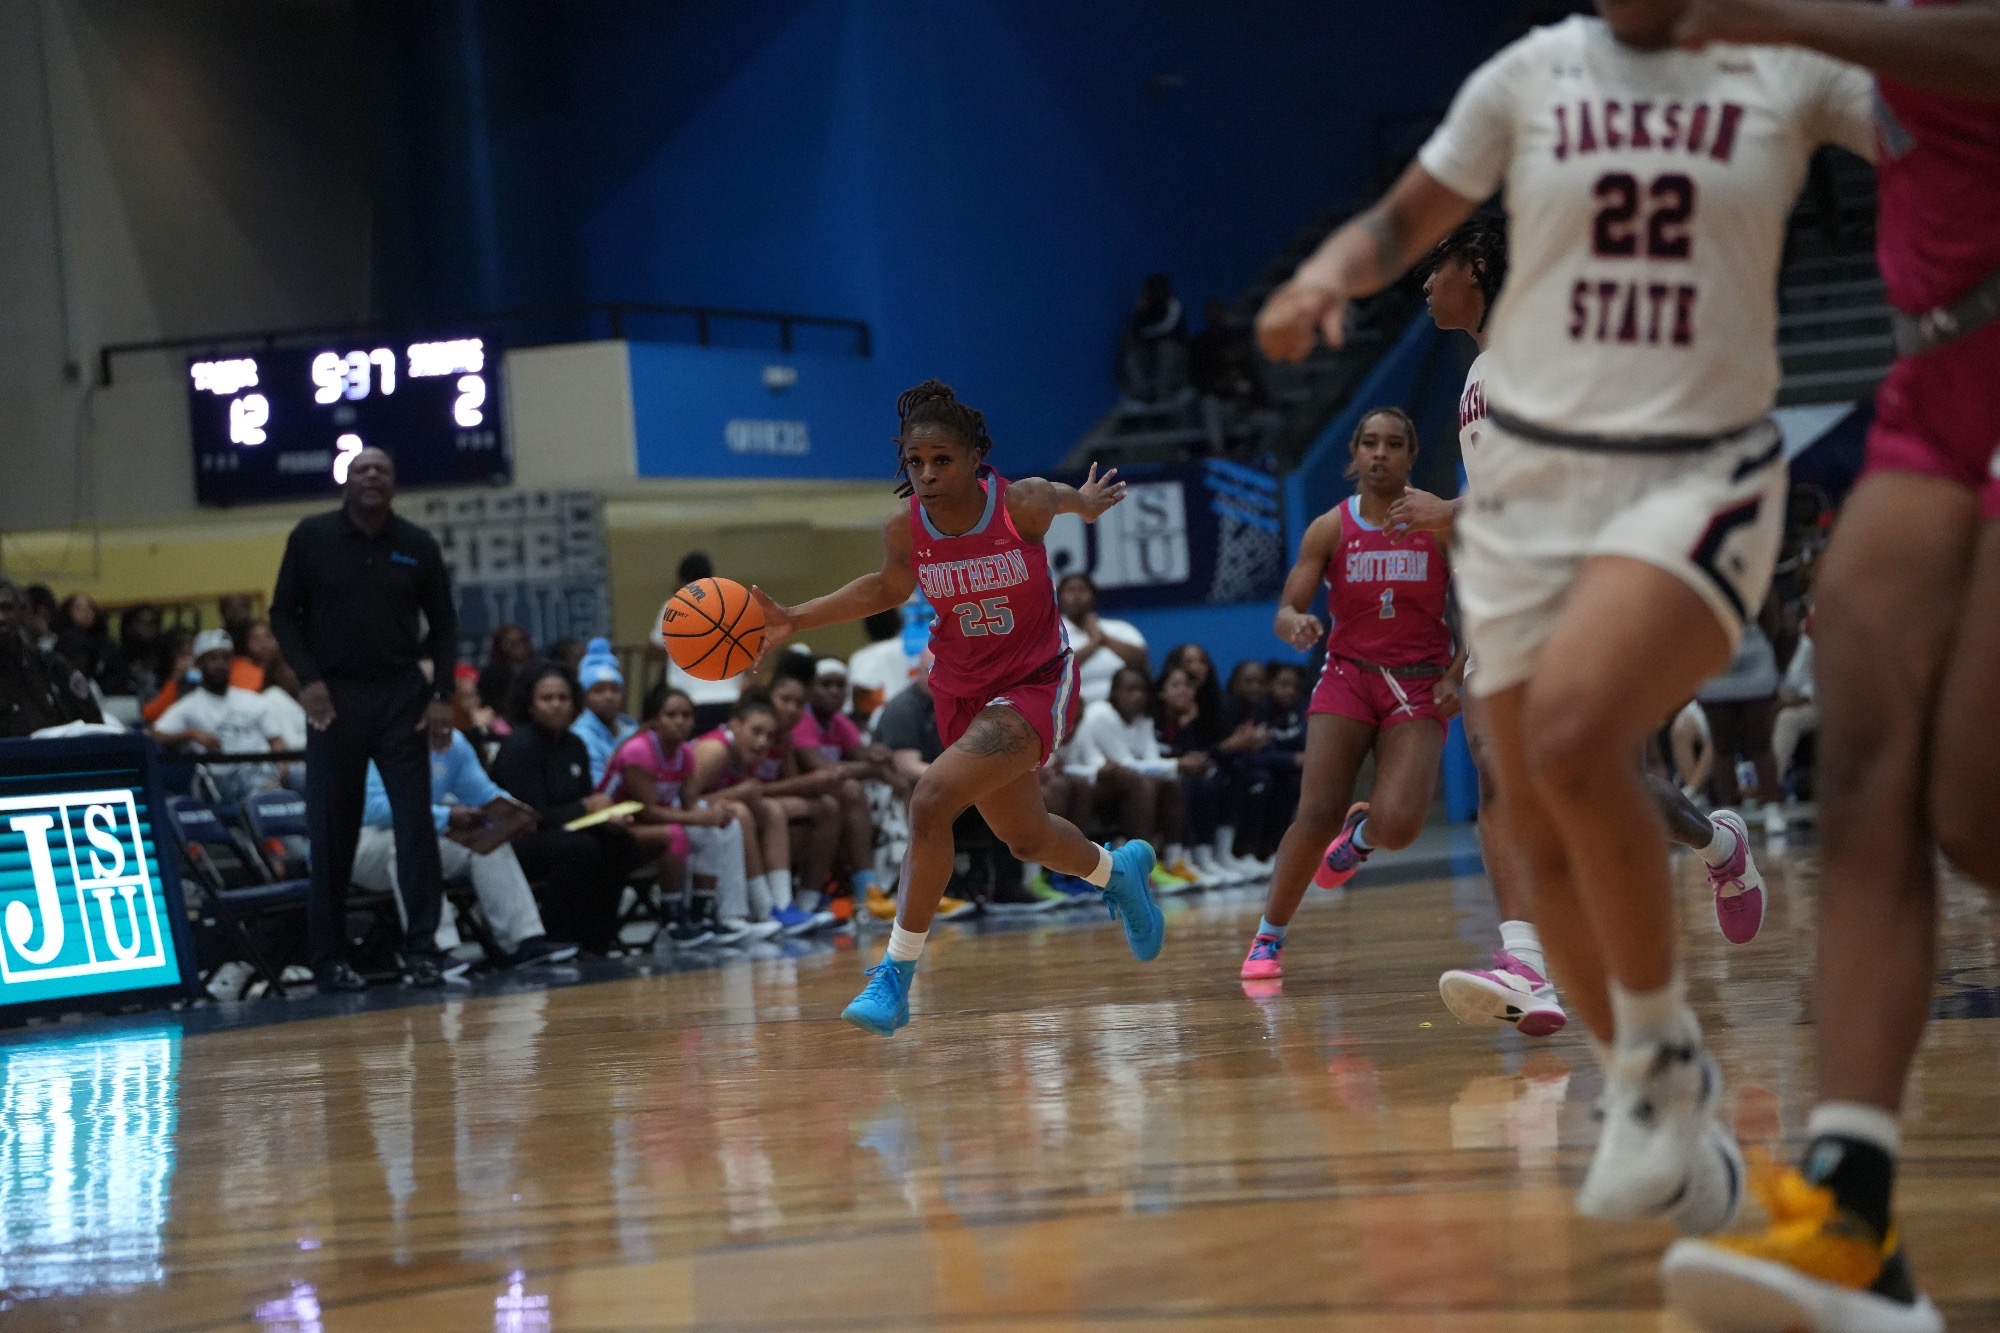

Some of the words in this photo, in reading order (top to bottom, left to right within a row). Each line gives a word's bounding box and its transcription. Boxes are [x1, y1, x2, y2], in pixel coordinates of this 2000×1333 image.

[1554, 99, 1744, 163] JACKSON
[1592, 173, 1695, 261] 22
[1569, 280, 1695, 345] STATE
[230, 394, 269, 445] 12
[454, 375, 486, 427] 2
[918, 548, 1030, 599] SOUTHERN
[1345, 549, 1429, 582] SOUTHERN
[952, 595, 1015, 637] 25
[1379, 587, 1396, 619] 1
